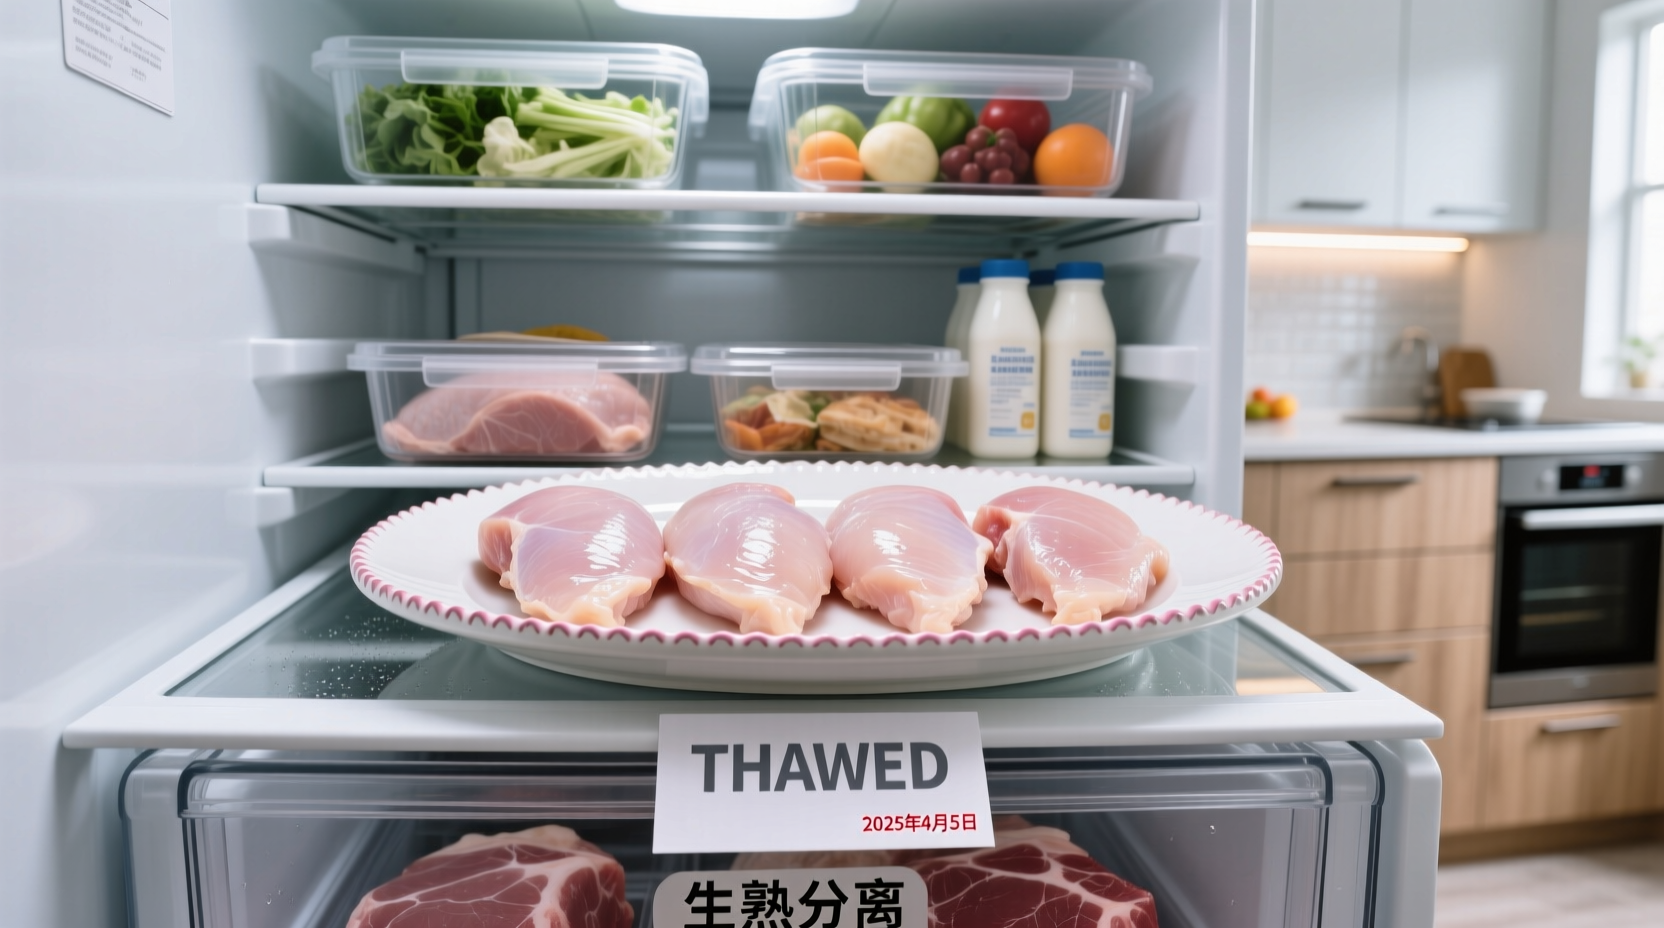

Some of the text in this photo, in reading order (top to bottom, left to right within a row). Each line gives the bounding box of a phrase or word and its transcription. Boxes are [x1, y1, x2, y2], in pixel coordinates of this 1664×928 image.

[691, 742, 949, 793] THAWED
[862, 813, 977, 833] 2025年4月5日
[684, 877, 905, 928] 生熟分离
